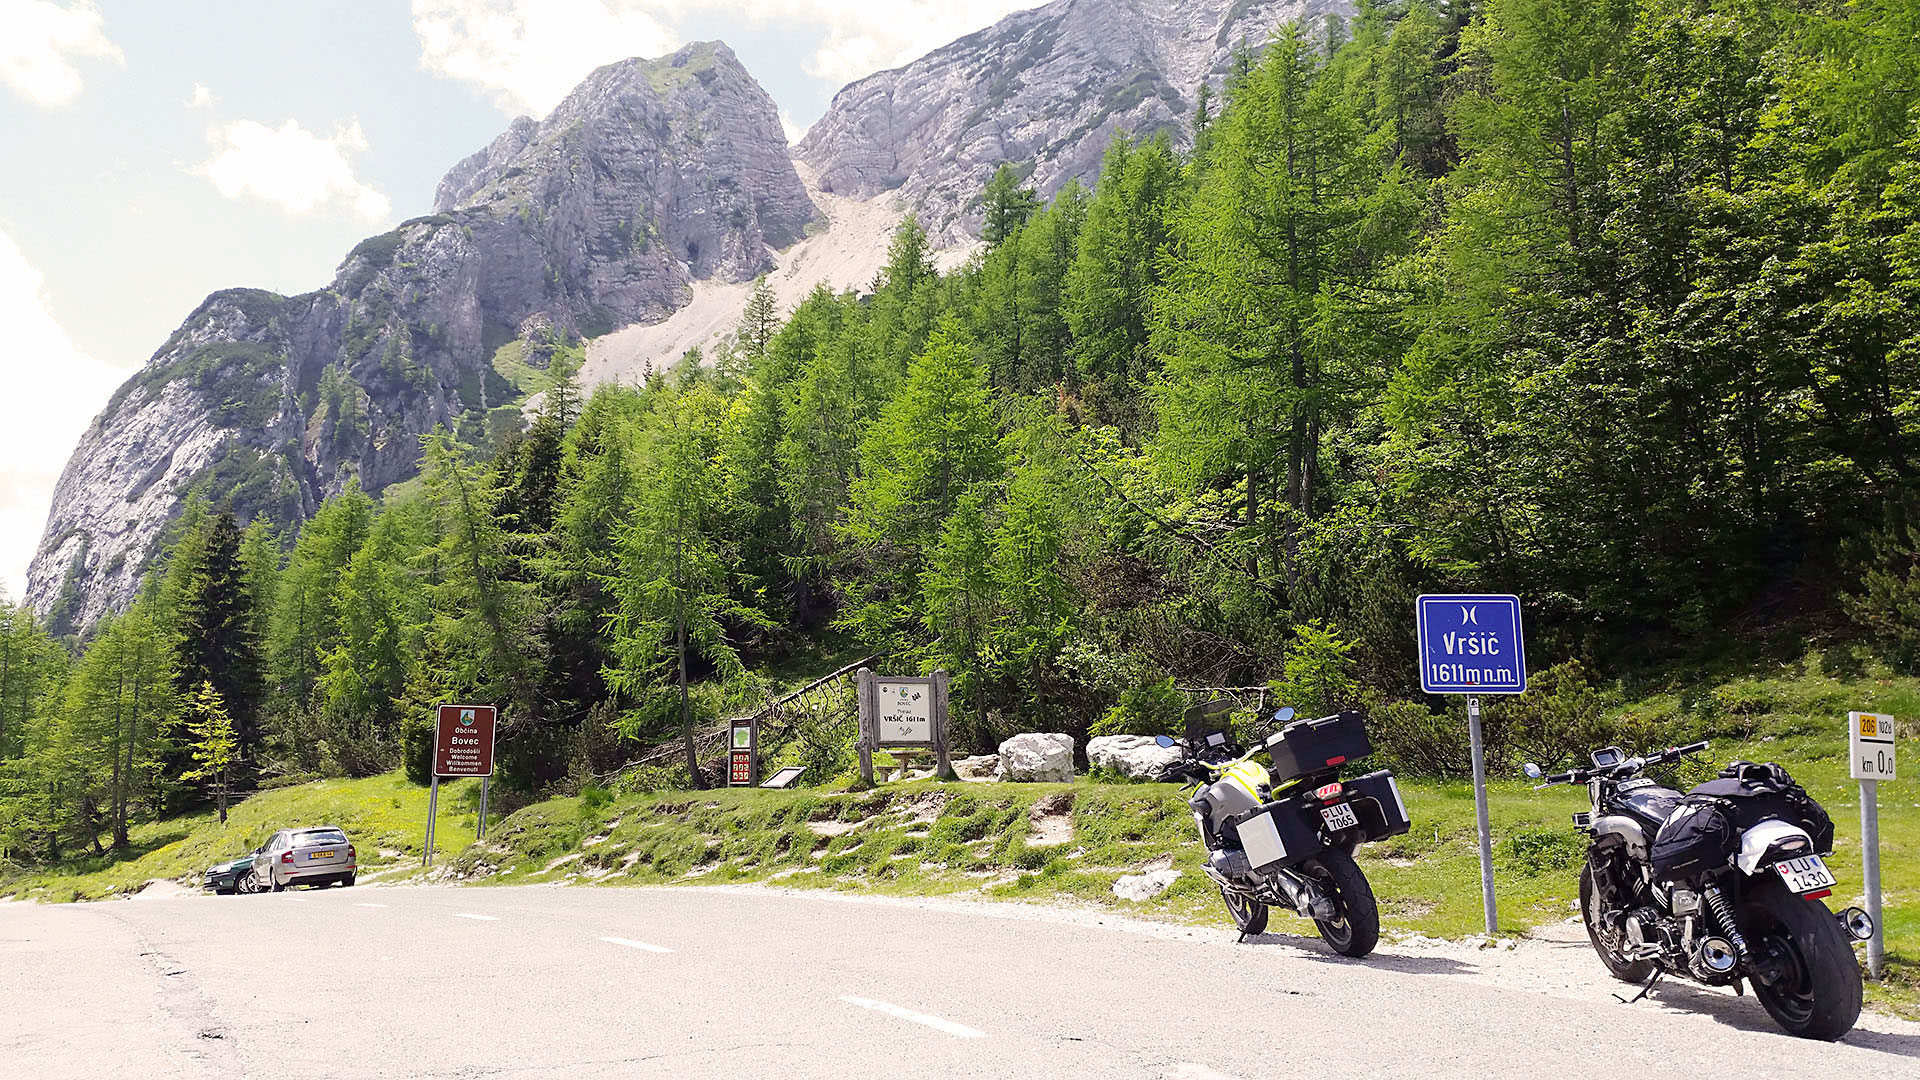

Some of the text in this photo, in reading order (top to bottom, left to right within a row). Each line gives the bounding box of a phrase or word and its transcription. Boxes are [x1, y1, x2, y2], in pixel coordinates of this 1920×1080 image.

[1443, 631, 1500, 655] Vršič
[1432, 663, 1516, 683] 1611m n.m.
[883, 714, 903, 722] VRŠIČ
[1862, 719, 1875, 733] 206
[451, 736, 479, 745] Bovec
[1862, 750, 1894, 775] km 0,0
[1329, 805, 1344, 818] LU
[1330, 814, 1355, 830] 7065
[1788, 857, 1811, 874] LU
[1792, 871, 1829, 890] 1430
